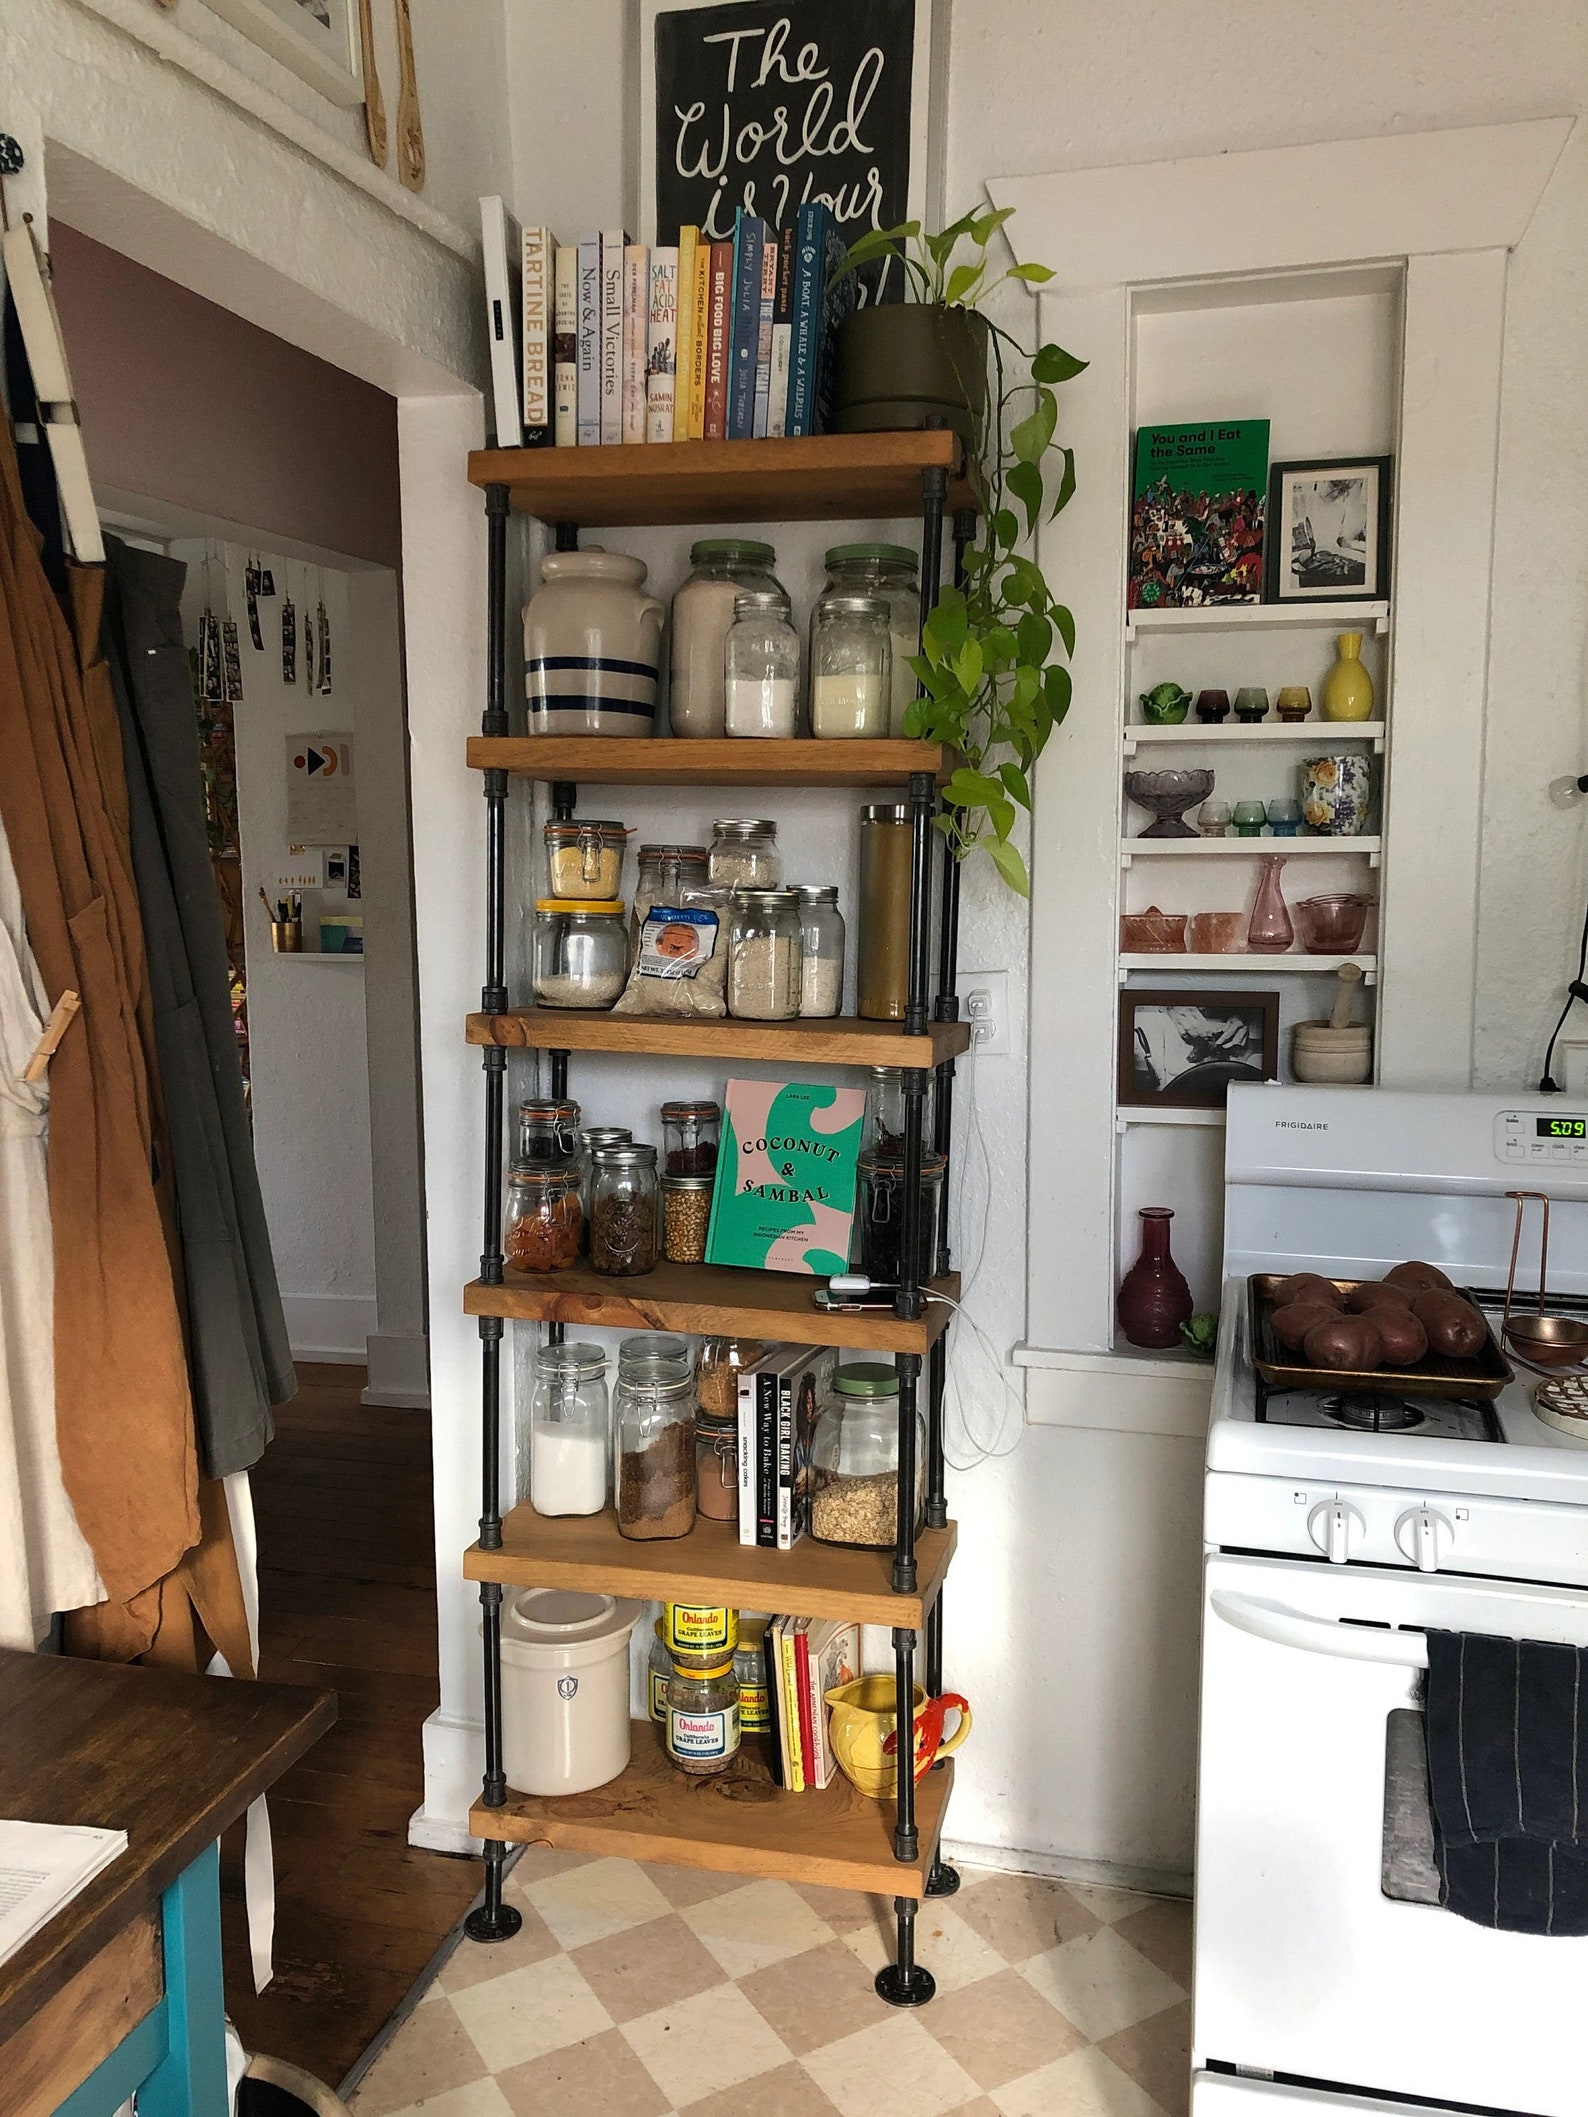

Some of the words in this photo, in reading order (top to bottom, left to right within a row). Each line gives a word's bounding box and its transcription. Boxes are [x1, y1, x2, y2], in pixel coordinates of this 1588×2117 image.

[703, 18, 830, 93] The
[675, 47, 884, 179] World
[701, 174, 759, 240] is
[772, 166, 886, 233] Your
[783, 228, 793, 251] back
[744, 232, 757, 272] SIMPLY
[525, 228, 544, 333] TARTINE
[651, 264, 677, 280] SALT
[762, 252, 770, 294] TERRY
[767, 245, 776, 294] BRYANT
[779, 253, 791, 287] pocket
[802, 268, 811, 279] A
[582, 267, 597, 303] Now
[605, 270, 621, 317] Small
[655, 279, 673, 293] FAT
[698, 271, 706, 314] KITCHEN
[714, 272, 725, 294] BIG
[652, 294, 675, 308] ACID
[742, 277, 753, 312] JULIA
[779, 288, 790, 313] pasta
[582, 307, 596, 322] &
[650, 308, 677, 323] HEAT
[713, 296, 724, 326] FOOD
[759, 302, 772, 319] THE
[801, 311, 809, 319] A
[580, 325, 597, 372] Again
[712, 328, 723, 350] BIG
[798, 320, 809, 355] WHALE
[604, 321, 621, 396] Victories
[693, 340, 703, 386] BORDERS
[710, 352, 722, 384] LOVE
[797, 356, 807, 365] &
[755, 363, 769, 392] VEGAN
[797, 367, 806, 375] A
[526, 342, 545, 424] BREAD
[650, 392, 673, 402] SAMIN
[794, 378, 806, 419] WALRUS
[648, 404, 674, 414] NOSRAT
[1151, 433, 1175, 445] You
[1179, 430, 1206, 443] and
[1218, 429, 1241, 441] Eat
[1150, 447, 1173, 458] the
[1176, 445, 1216, 457] Same
[1275, 1120, 1329, 1131] FRIGIDAIRE
[742, 1137, 840, 1164] COCONUT
[781, 1162, 795, 1177] &
[742, 1179, 830, 1203] SAMBAL
[753, 1232, 785, 1241] INDONESIAN
[786, 1235, 809, 1243] KITCHEN
[758, 1226, 780, 1234] RECIPES
[763, 1378, 772, 1386] A
[763, 1389, 772, 1411] New
[780, 1390, 791, 1418] BLACK
[761, 1414, 772, 1434] Way
[780, 1421, 791, 1440] GIRL
[763, 1436, 771, 1447] to
[762, 1449, 772, 1475] Bake
[779, 1444, 791, 1476] BAKING
[682, 1611, 719, 1624] Orlando
[678, 1629, 698, 1637] GRAPE
[740, 1691, 765, 1703] lando
[679, 1718, 715, 1732] Orlando
[675, 1735, 694, 1744] GRAPE
